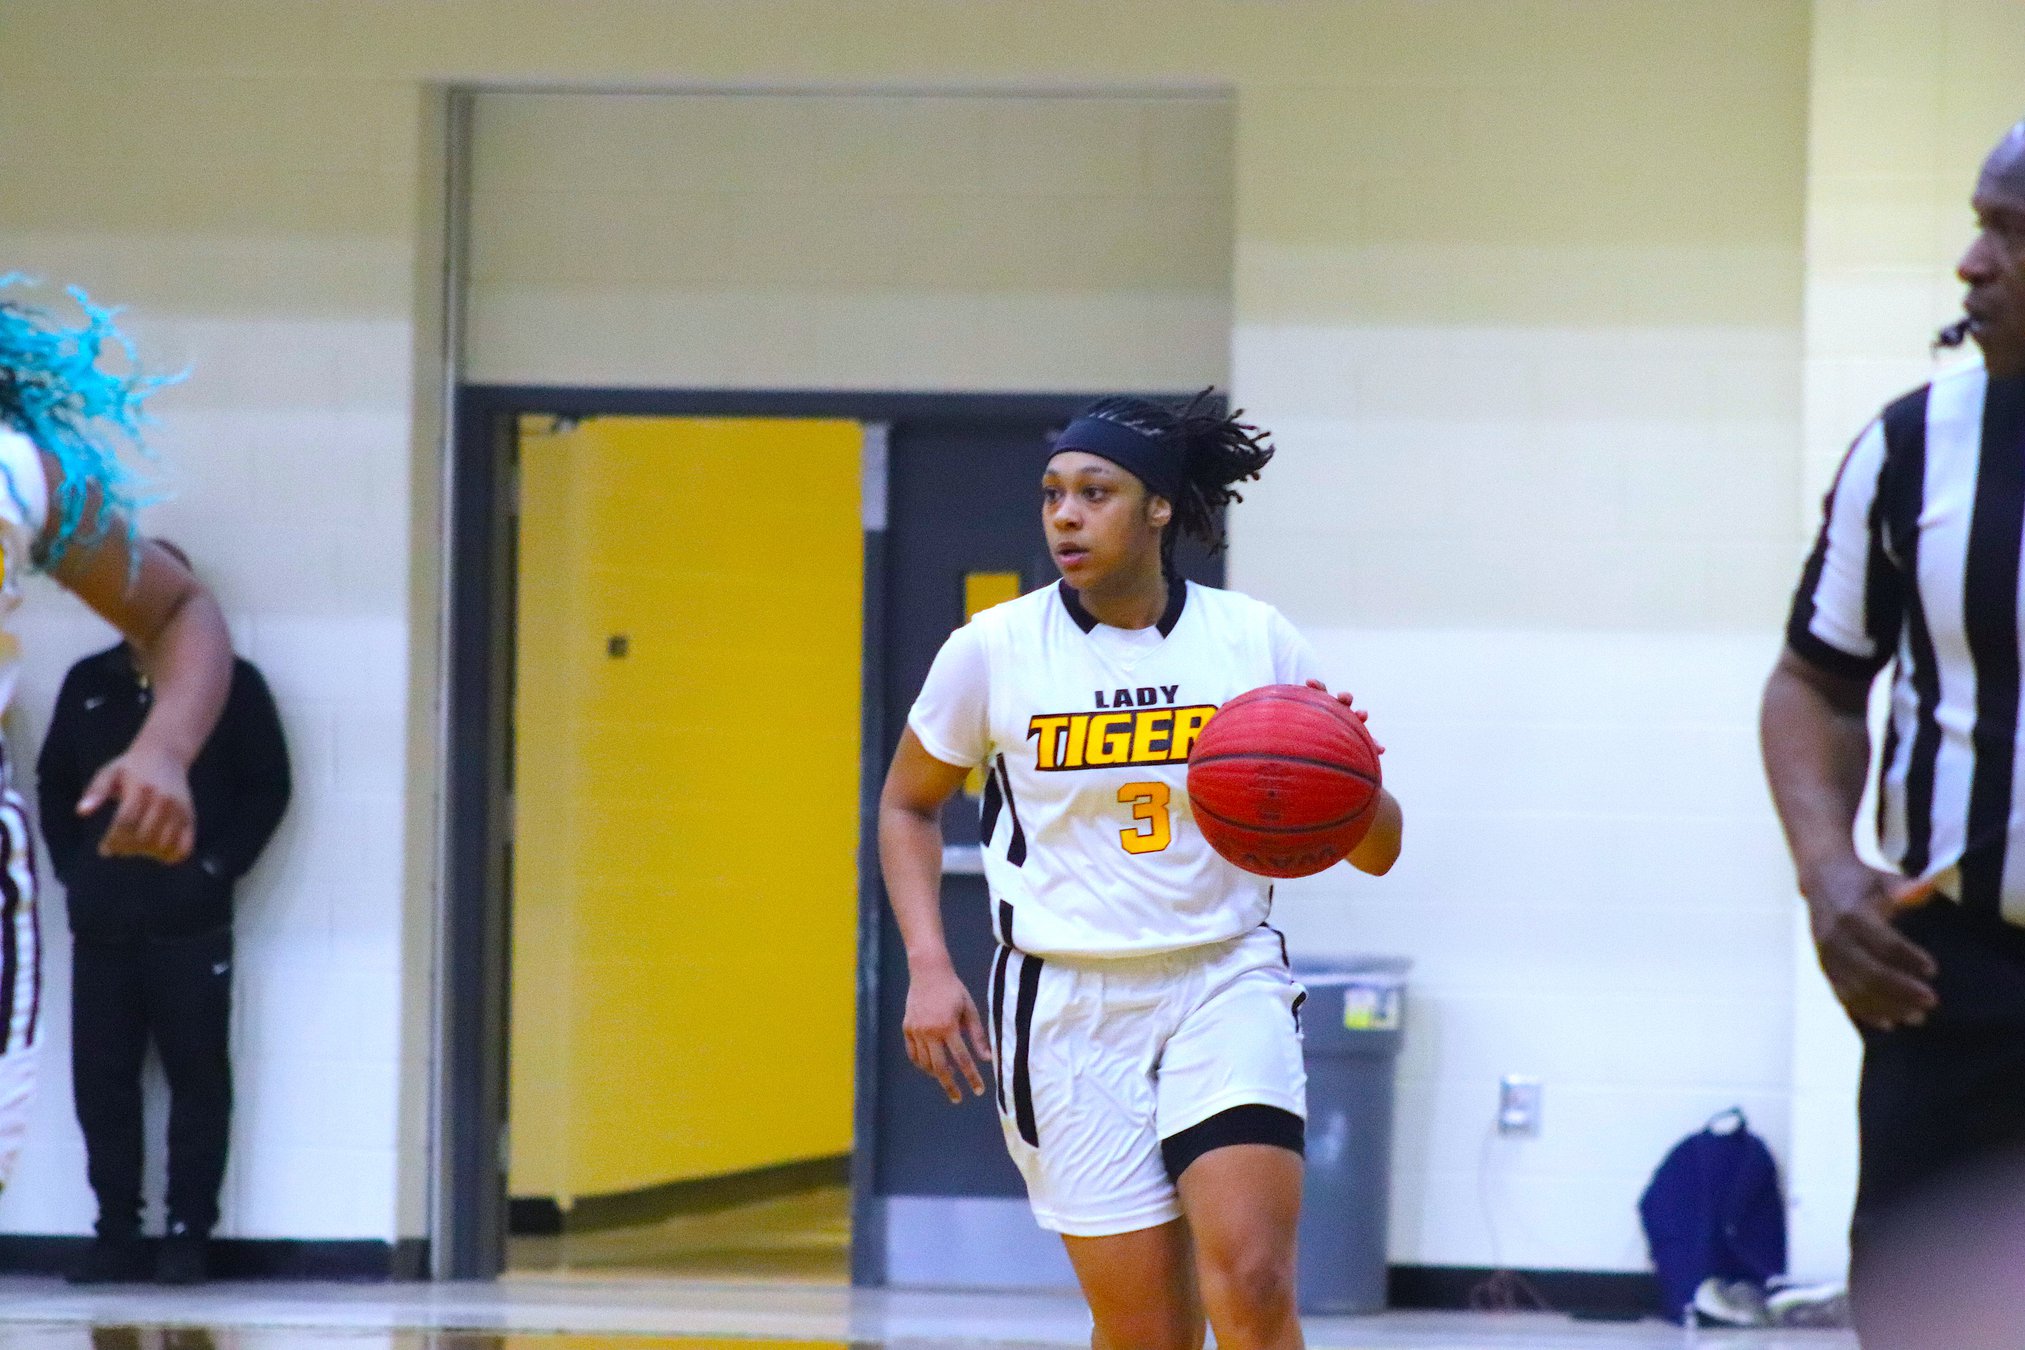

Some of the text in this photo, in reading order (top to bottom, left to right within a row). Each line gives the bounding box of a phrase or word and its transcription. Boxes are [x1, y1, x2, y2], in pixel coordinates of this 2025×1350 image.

[1094, 684, 1179, 708] LADY
[1026, 704, 1219, 771] TIGER
[1117, 781, 1172, 854] 3
